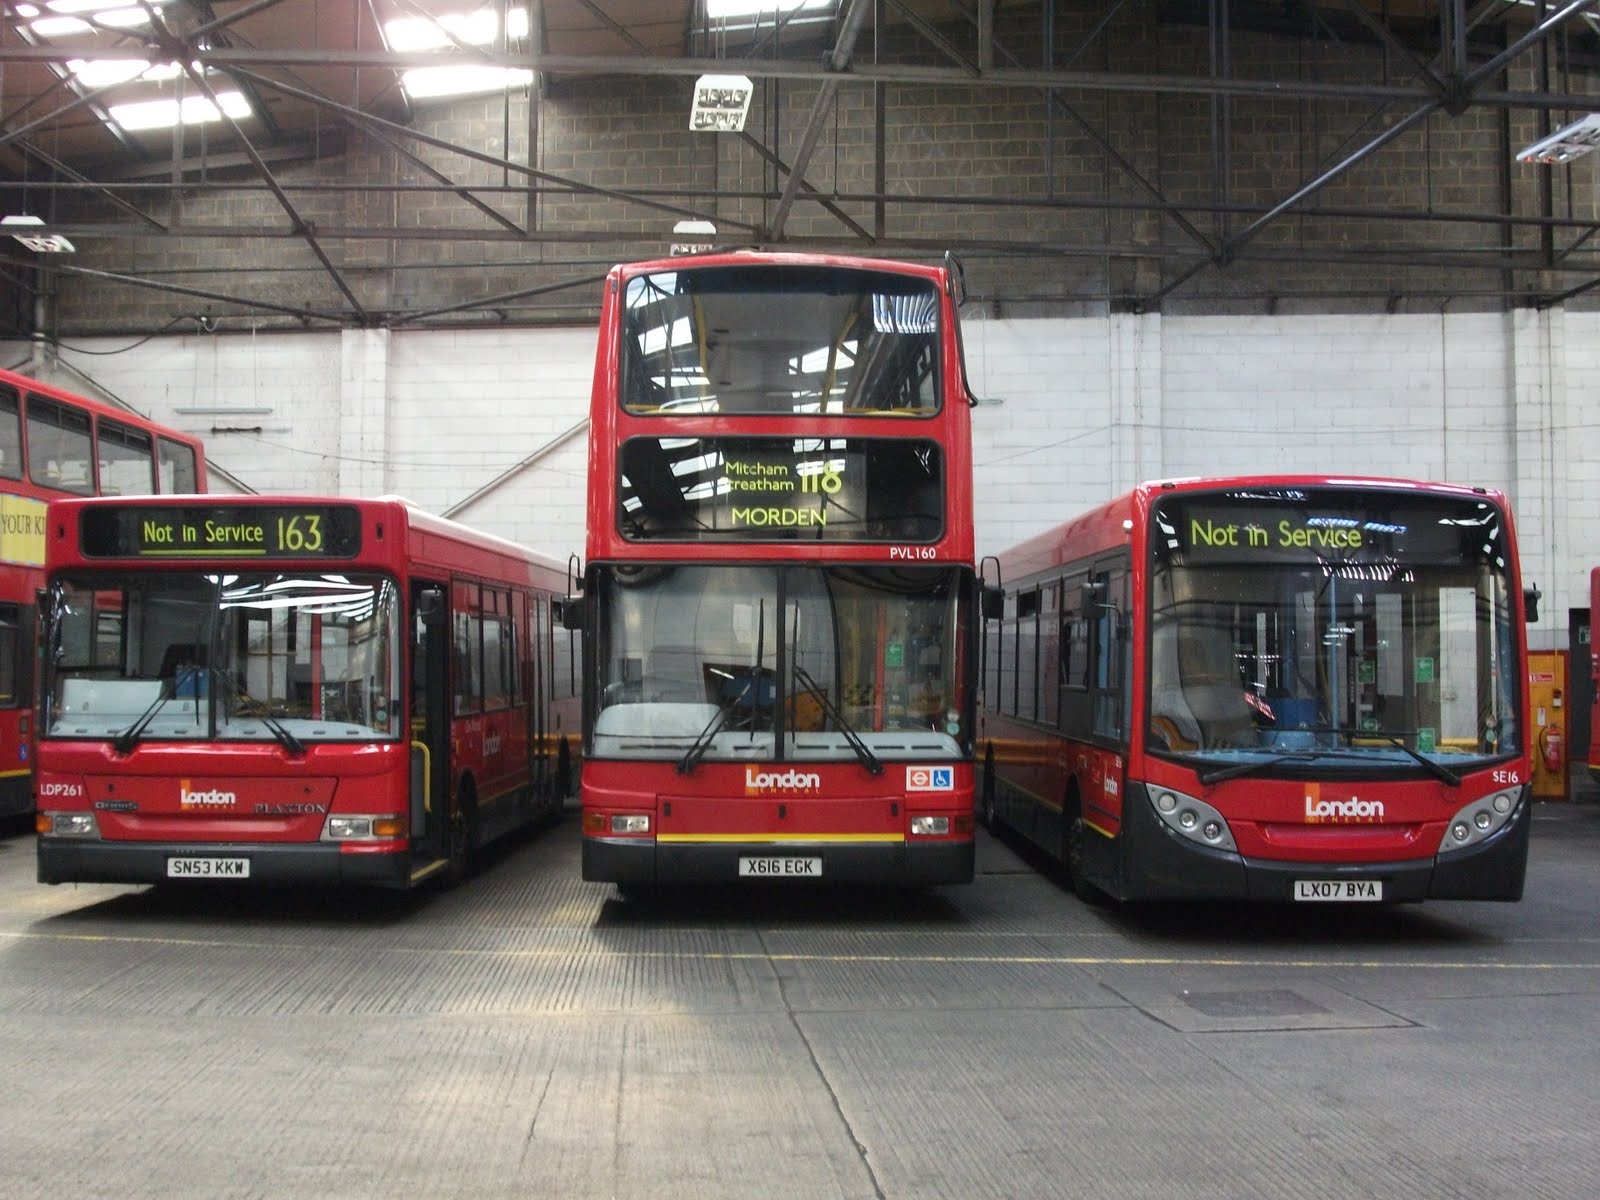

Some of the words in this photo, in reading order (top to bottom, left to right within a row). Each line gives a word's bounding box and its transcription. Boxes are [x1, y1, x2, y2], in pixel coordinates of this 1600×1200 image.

[726, 461, 788, 475] Mitcham
[727, 477, 794, 491] treatham
[802, 461, 841, 493] 118
[2, 513, 31, 534] YOUR
[732, 507, 826, 526] MORDEN
[144, 521, 173, 542] Not
[183, 524, 196, 542] in
[205, 520, 263, 542] Service
[278, 515, 321, 550] 163
[1192, 519, 1238, 546] Not
[1249, 523, 1268, 546] in
[1279, 520, 1362, 547] Service
[890, 547, 936, 559] PVL160
[746, 769, 820, 787] London
[1492, 770, 1519, 783] SE16
[40, 784, 82, 796] LDP261
[181, 789, 236, 804] London
[255, 803, 326, 813] PLAXTON
[1306, 796, 1384, 816] London
[174, 861, 211, 874] SN53
[215, 861, 243, 874] KKW
[748, 860, 780, 873] X616
[785, 860, 813, 873] EGK
[1301, 883, 1341, 897] LX07
[1346, 883, 1376, 897] BYA
